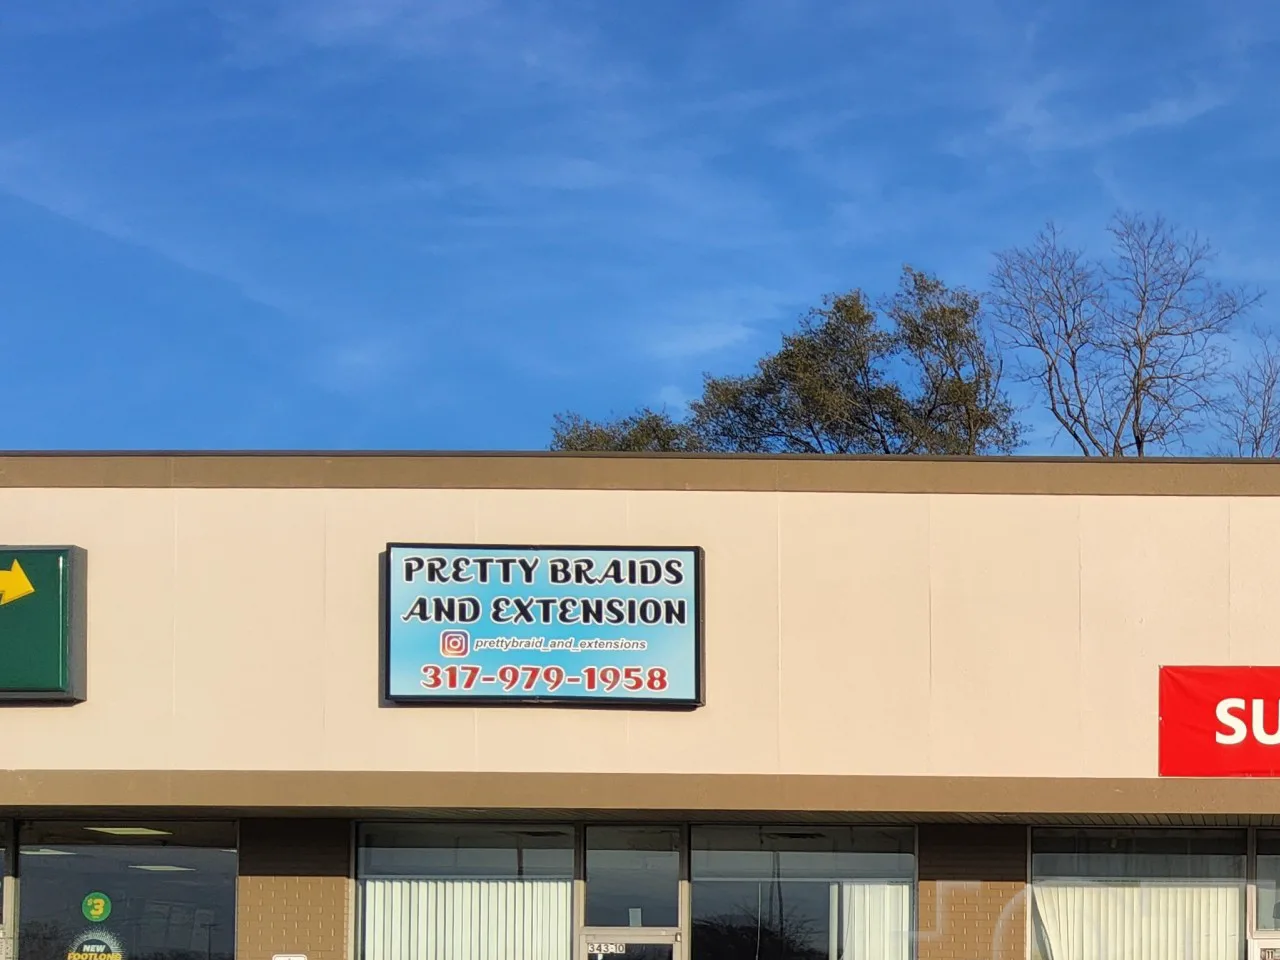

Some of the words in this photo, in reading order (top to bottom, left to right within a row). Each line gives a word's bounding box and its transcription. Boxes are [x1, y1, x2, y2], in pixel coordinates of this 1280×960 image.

[403, 557, 539, 584] PRETTY
[549, 558, 684, 585] BRAIDS
[402, 597, 481, 622] AND
[491, 597, 687, 625] EXTENSION
[474, 637, 647, 651] prettybraid_and_extensions
[421, 665, 668, 691] 317-979-1958
[83, 944, 106, 953] NEW
[588, 944, 625, 953] 343-10
[67, 953, 121, 960] FOOTLONG
